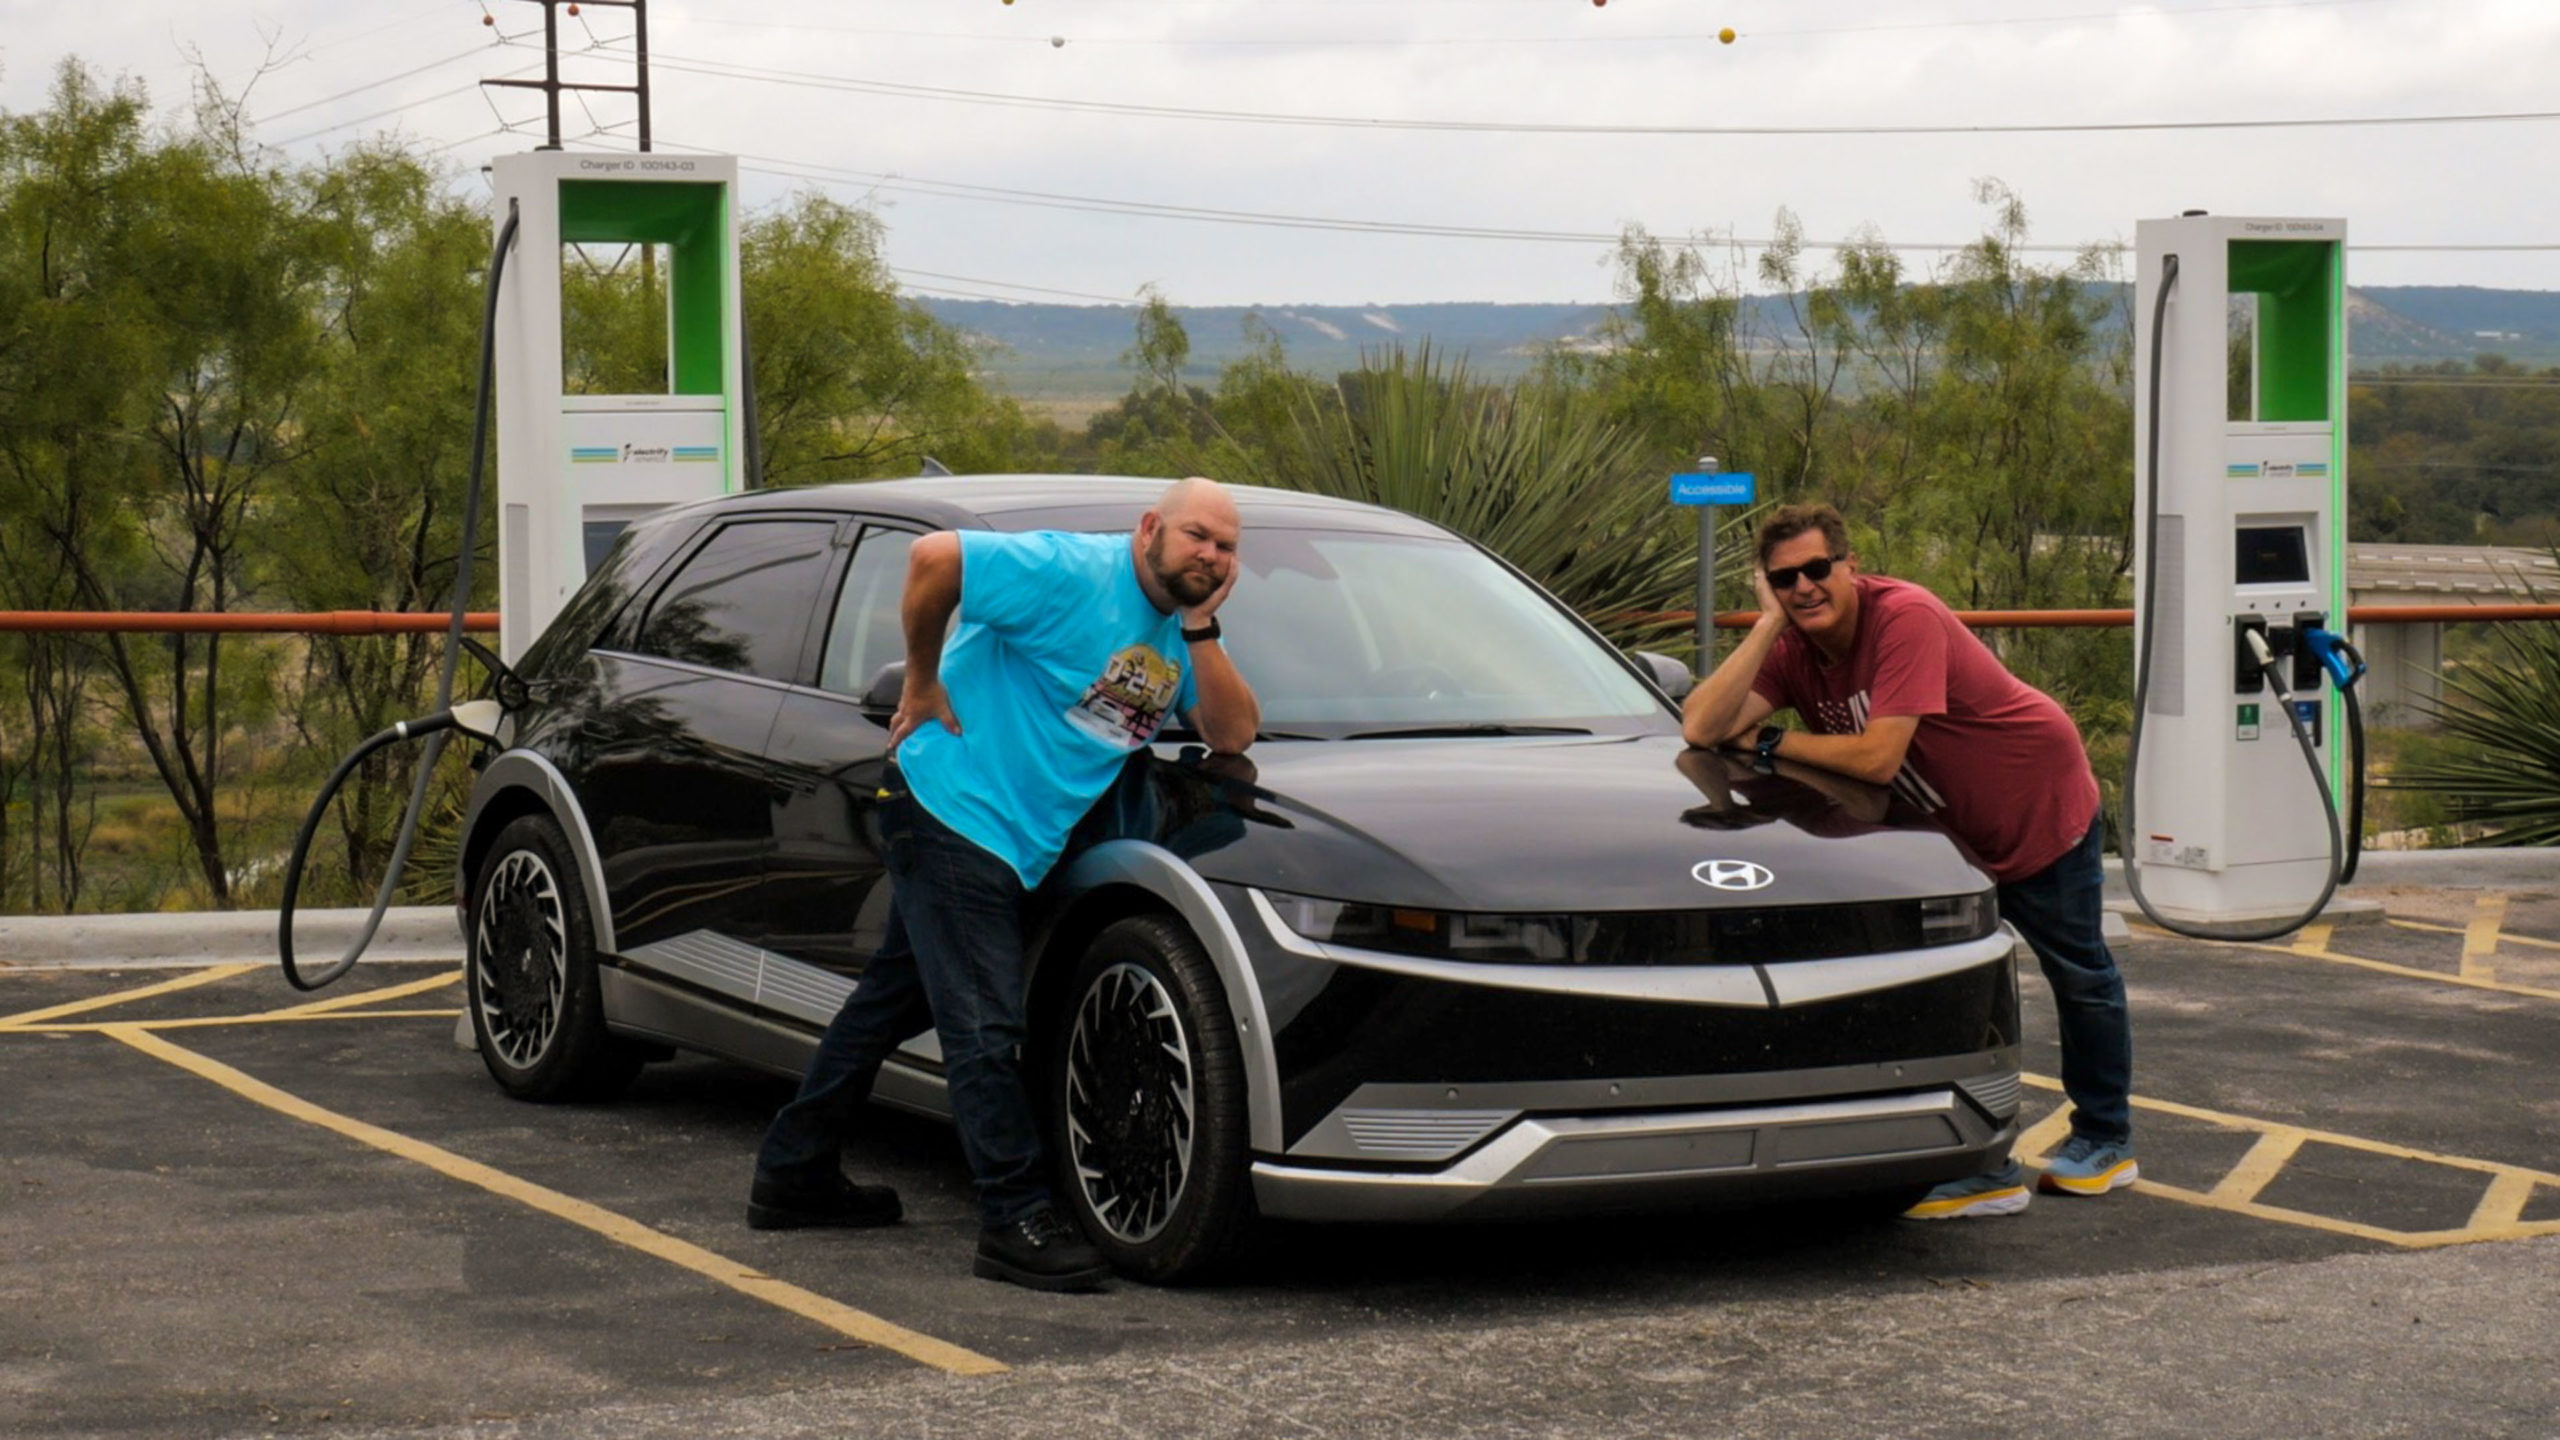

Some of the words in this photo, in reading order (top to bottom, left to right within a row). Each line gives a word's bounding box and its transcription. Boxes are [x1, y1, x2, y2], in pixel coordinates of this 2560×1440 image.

[580, 160, 620, 172] Charger
[623, 160, 635, 170] ID
[1678, 482, 1747, 495] Accessible
